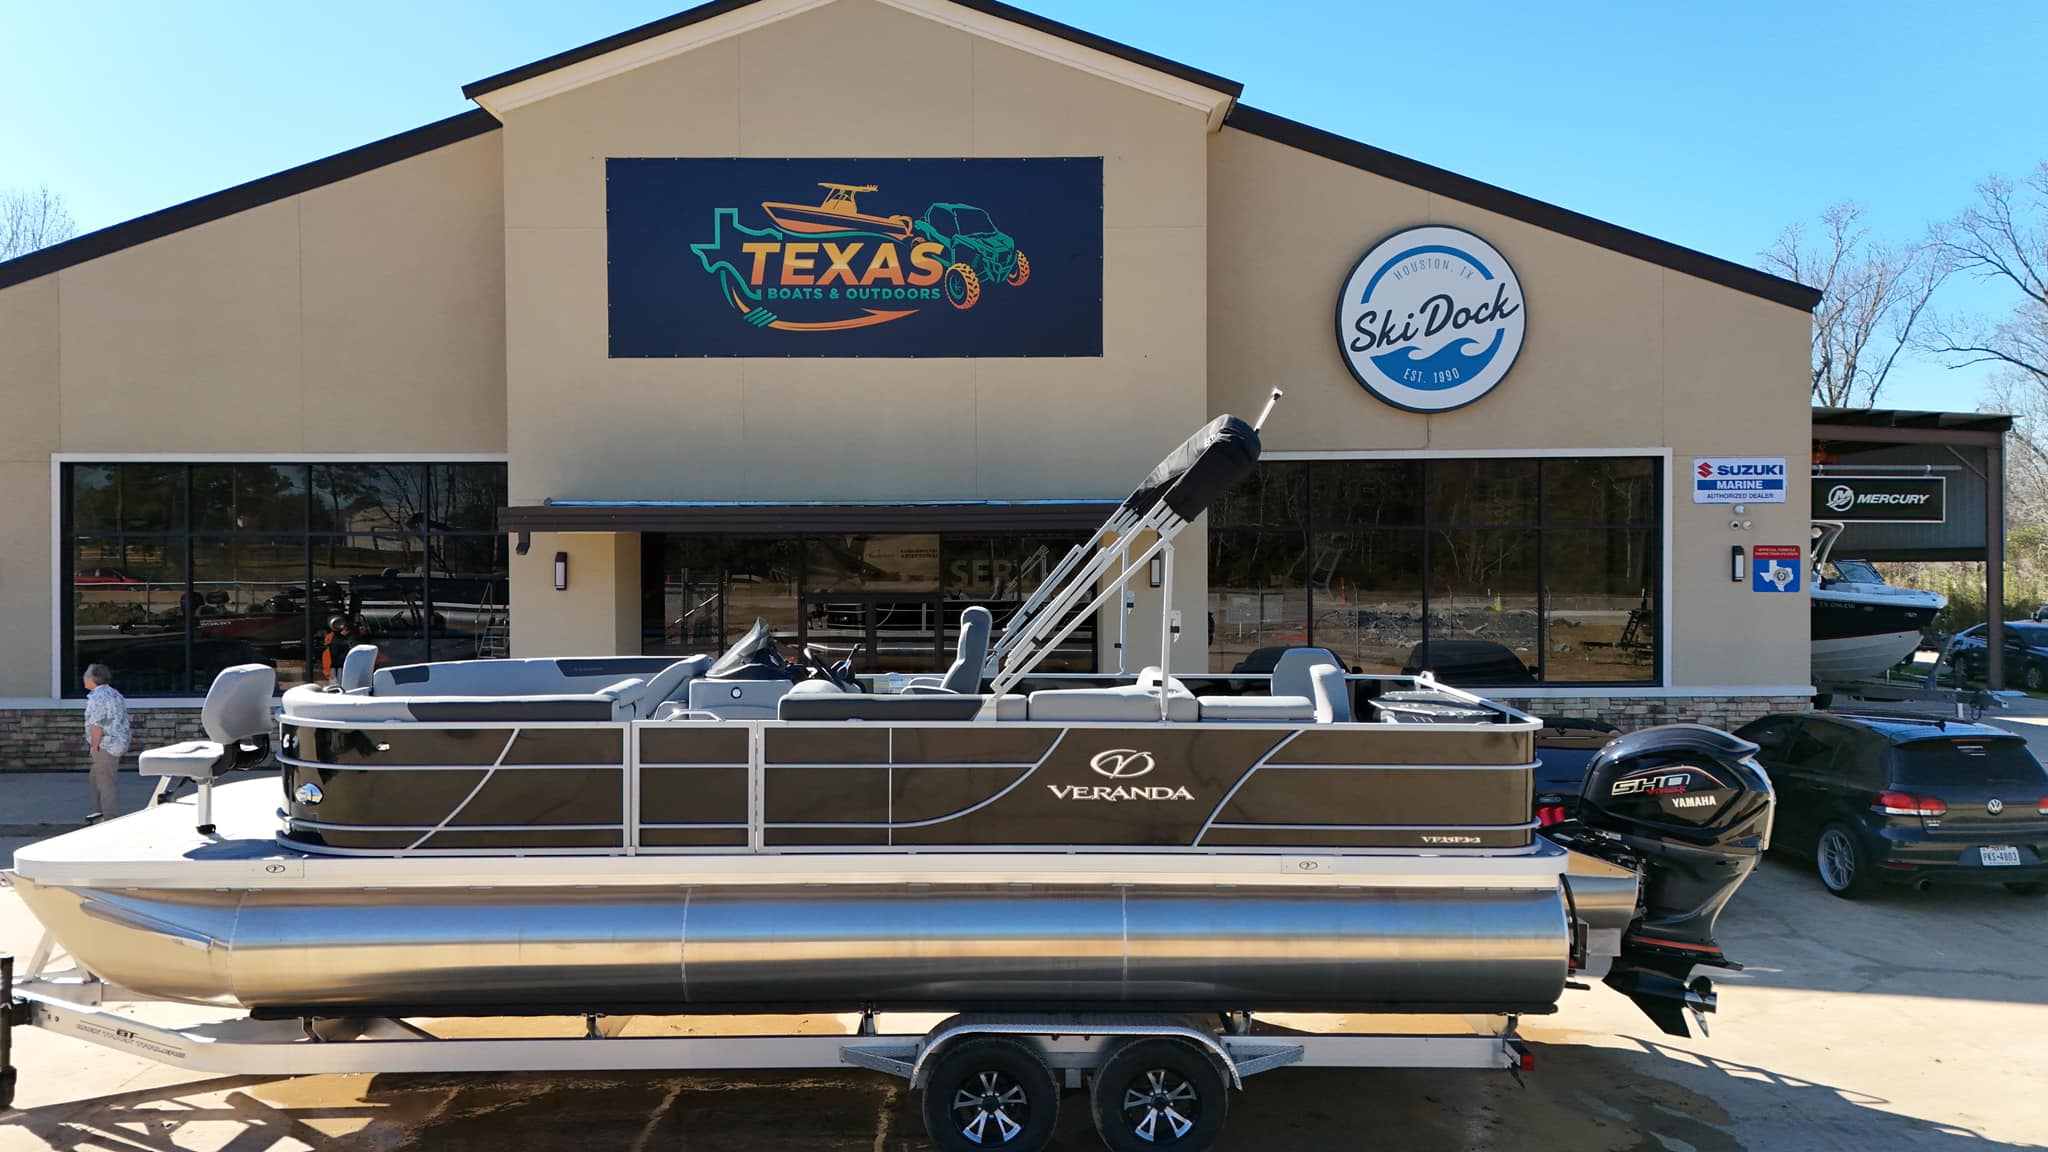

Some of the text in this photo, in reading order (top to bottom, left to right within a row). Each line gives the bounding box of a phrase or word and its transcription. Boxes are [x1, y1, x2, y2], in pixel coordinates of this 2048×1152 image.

[742, 242, 945, 287] TEXAS
[1460, 266, 1475, 281] TX
[767, 287, 941, 300] BOATS & OUTDOORS
[1350, 282, 1520, 352] Ski Dock
[1403, 367, 1461, 384] EST. 1990
[1717, 464, 1784, 476] SUZUKI
[1716, 480, 1764, 489] MARINE
[1856, 493, 1931, 504] MERCURY
[1611, 773, 1691, 796] SHO
[1047, 785, 1196, 802] VERANDA
[1671, 795, 1717, 808] YAMAHA
